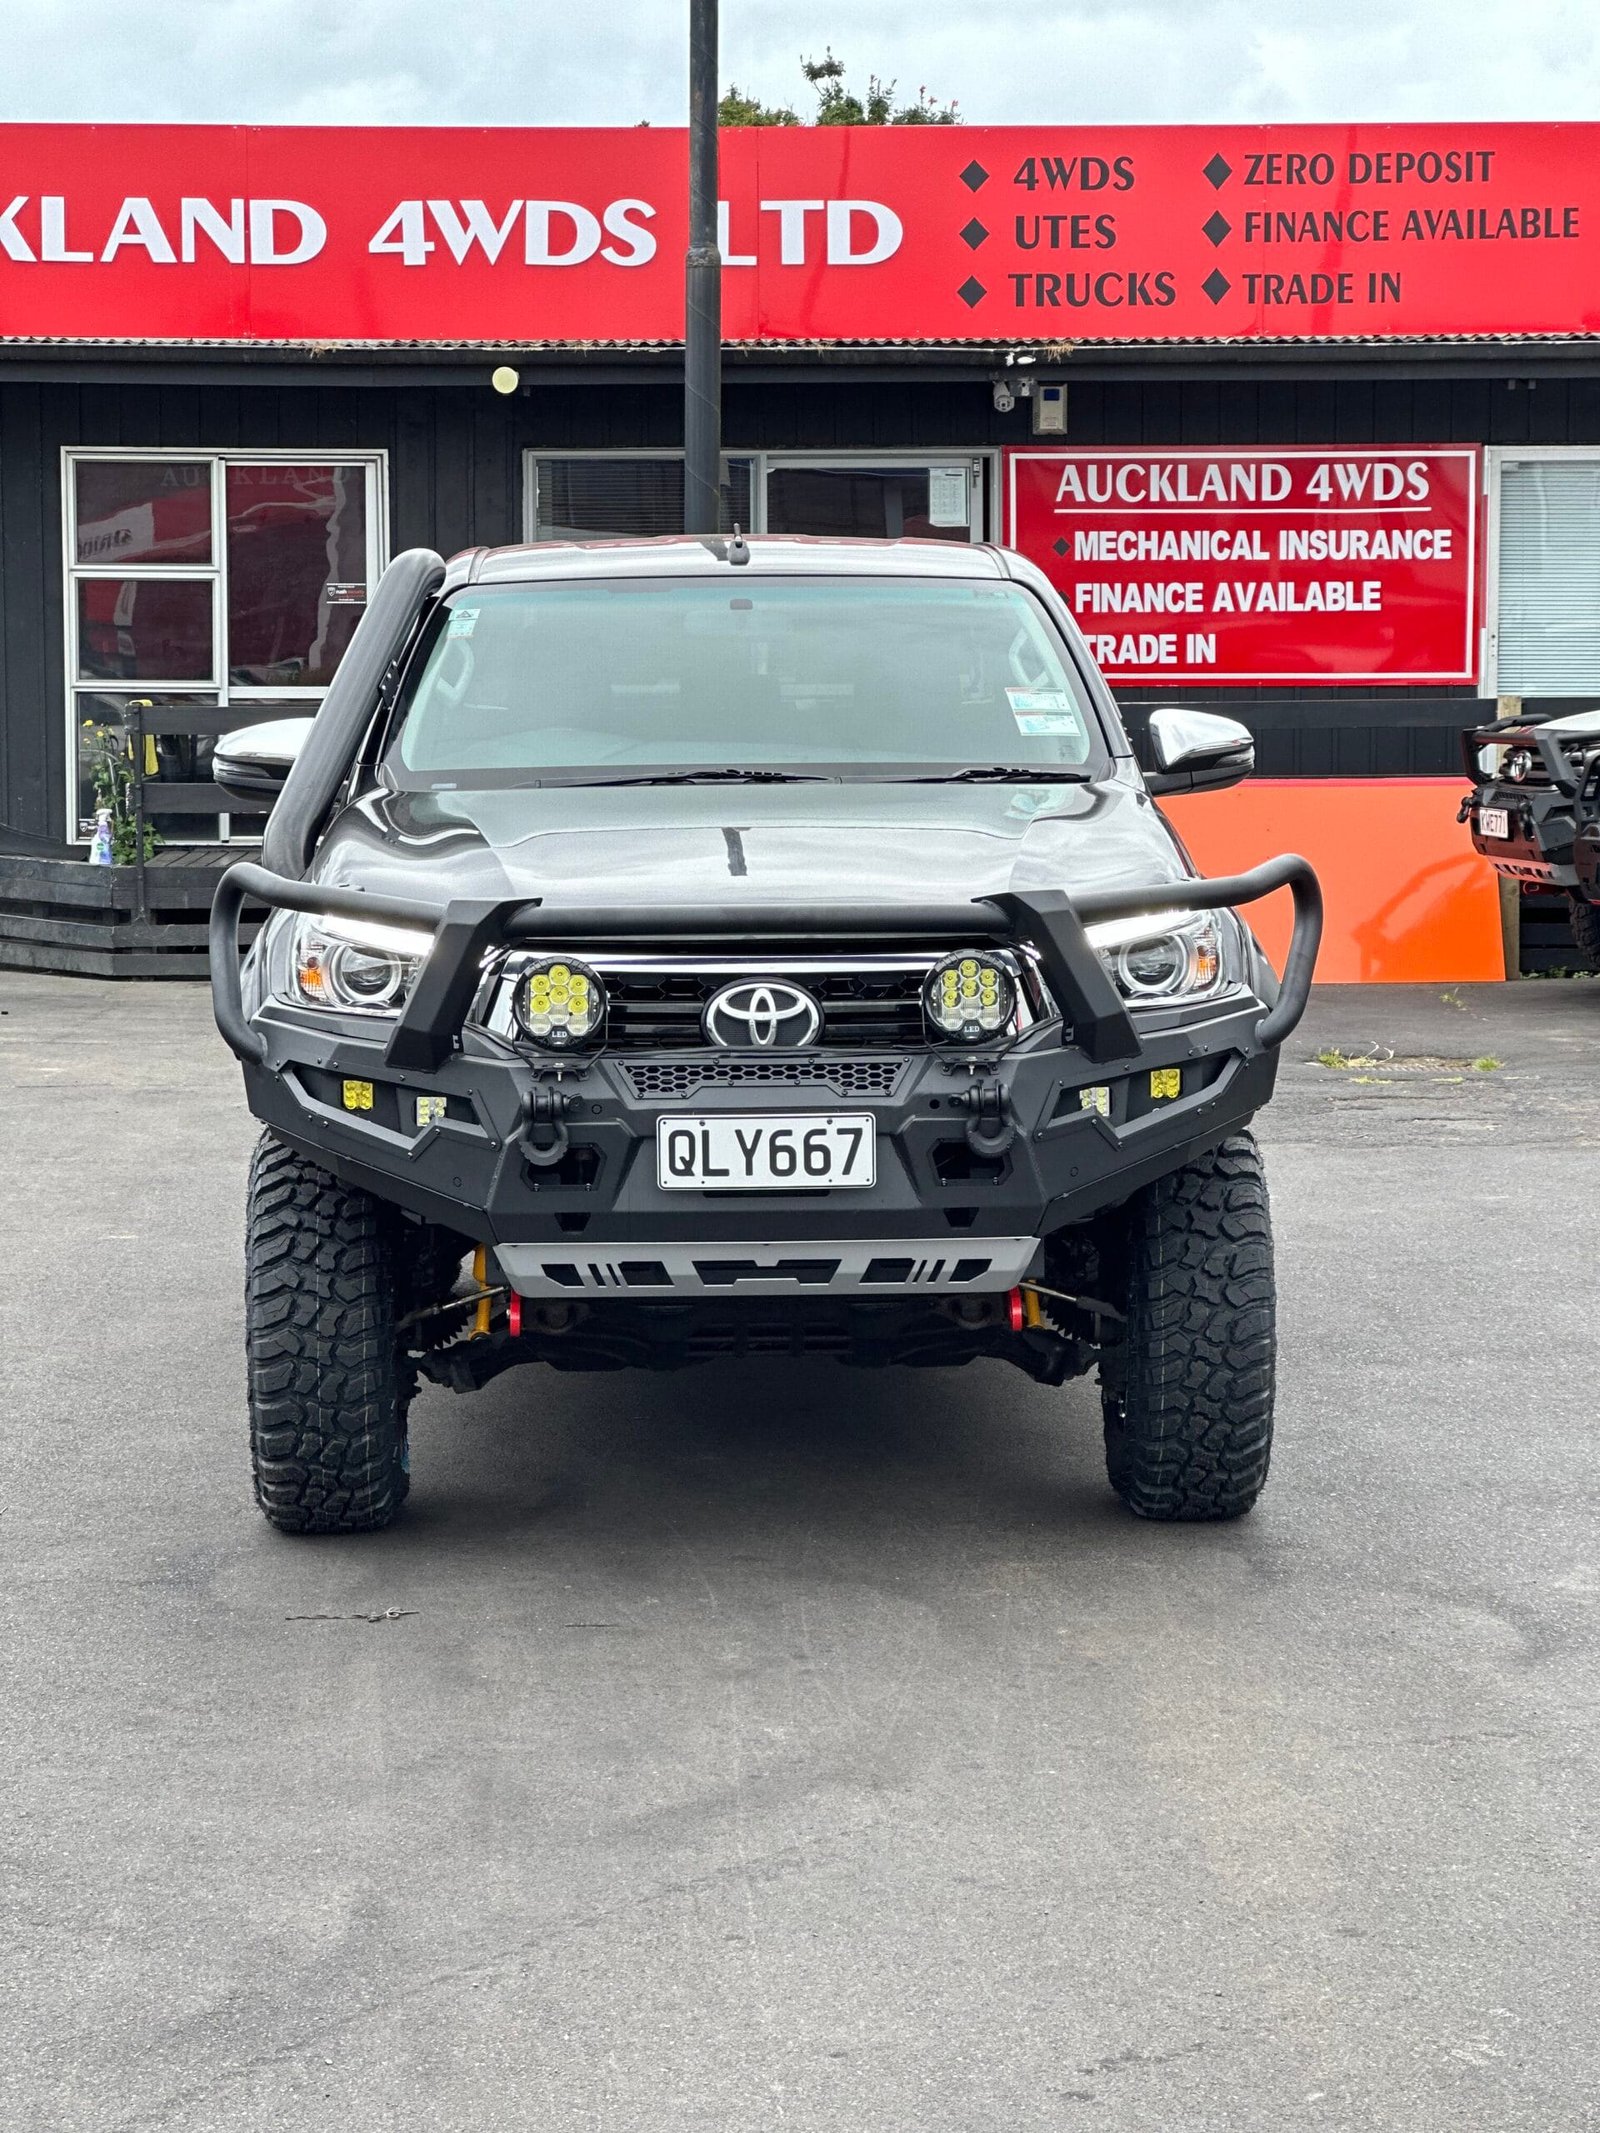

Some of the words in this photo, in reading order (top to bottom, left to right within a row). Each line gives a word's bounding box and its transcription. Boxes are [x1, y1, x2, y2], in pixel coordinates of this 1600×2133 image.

[1014, 156, 1134, 191] 4WDS
[1244, 153, 1335, 186] ZERO
[1349, 151, 1494, 184] DEPOSIT
[368, 198, 657, 267] 4WDS
[717, 200, 904, 266] LTD
[1015, 214, 1116, 249] UTES
[1245, 210, 1388, 242] FINANCE
[1402, 207, 1579, 240] AVAILABLE
[1009, 272, 1176, 307] TRUCKS
[1242, 273, 1353, 304] TRADE
[1369, 273, 1401, 303] IN
[1055, 463, 1293, 503] AUCKLAND
[1306, 461, 1430, 502] 4WDS
[1074, 529, 1270, 561] MECHANICAL
[1279, 529, 1453, 560] INSURANCE
[1075, 582, 1204, 613] FINANCE
[1212, 581, 1382, 612] AVAILABLE
[1186, 633, 1217, 664] IN
[551, 1030, 568, 1038] LED
[963, 1025, 980, 1033] LED
[668, 1128, 863, 1177] QLY667
